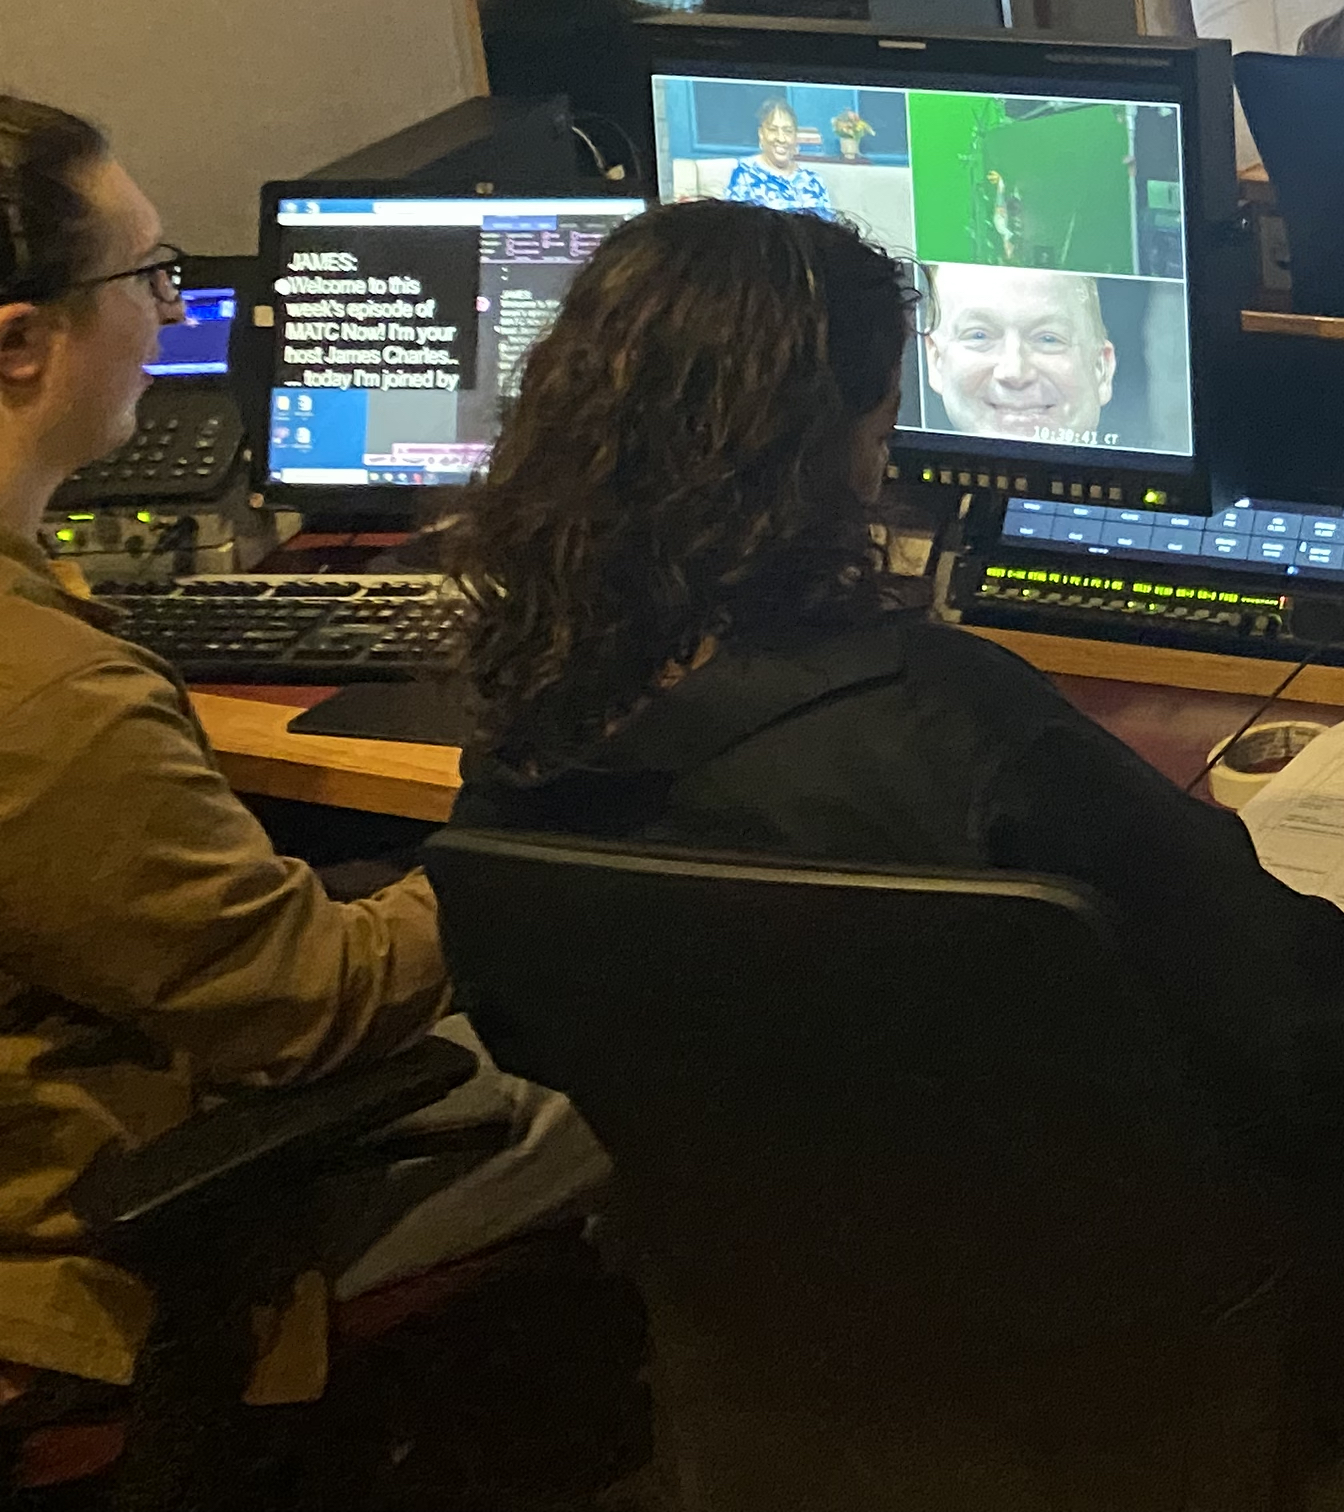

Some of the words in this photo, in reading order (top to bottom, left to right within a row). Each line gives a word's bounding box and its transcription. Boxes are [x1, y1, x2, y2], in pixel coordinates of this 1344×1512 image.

[287, 252, 358, 272] JAMES:
[289, 276, 366, 295] Welcome
[368, 277, 386, 295] to
[388, 276, 421, 295] this
[285, 299, 345, 318] week's
[347, 299, 412, 321] episode
[415, 298, 436, 318] of
[284, 322, 339, 342] MATC
[341, 322, 386, 342] Now!
[388, 322, 414, 341] I'm
[416, 325, 457, 345] your
[284, 345, 322, 364] host
[323, 346, 381, 365] James
[303, 368, 352, 390] today
[354, 368, 380, 387] I'm
[382, 368, 434, 390] joined
[436, 368, 460, 391] by
[1103, 433, 1119, 445] CT
